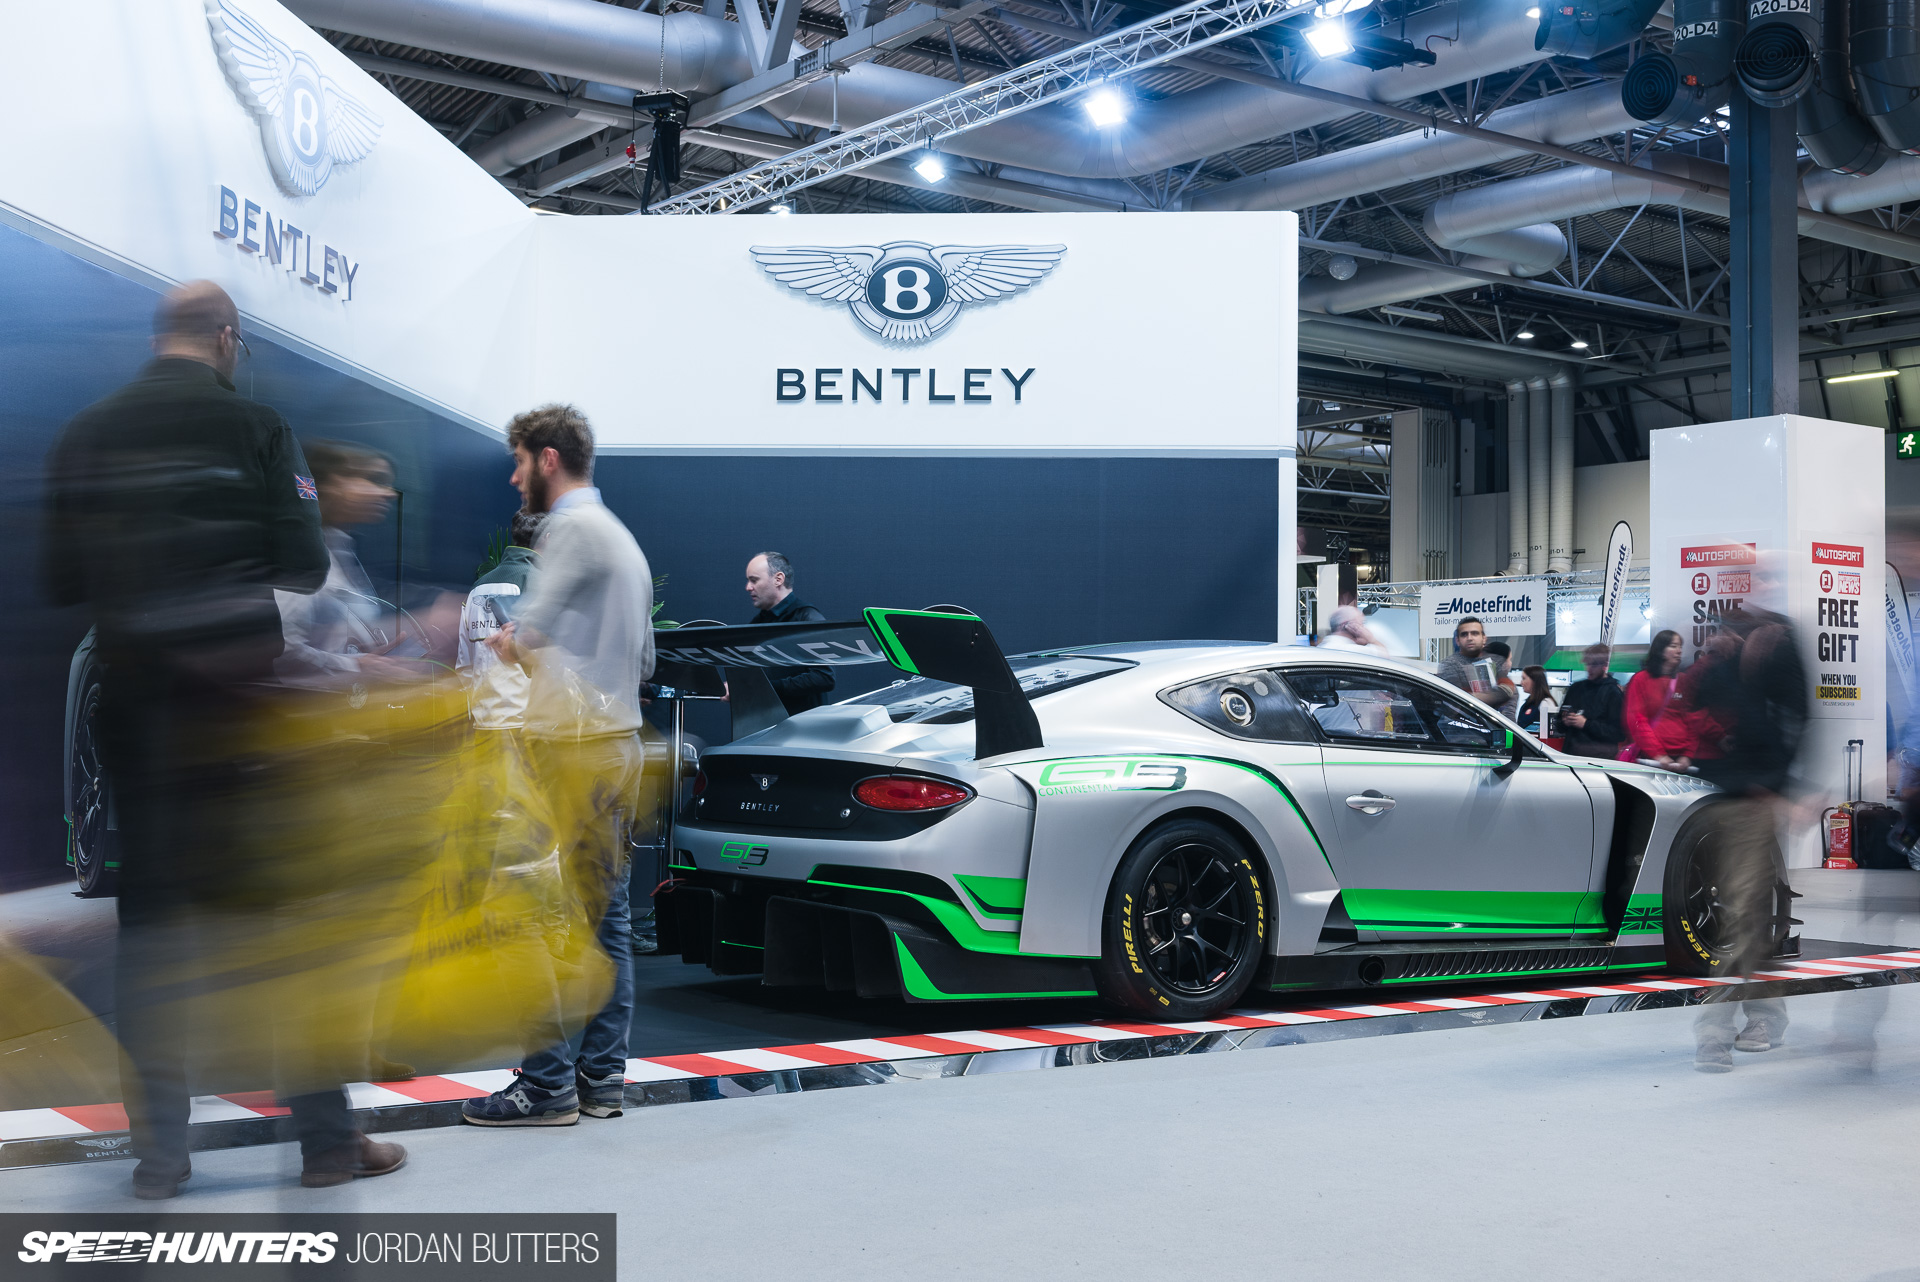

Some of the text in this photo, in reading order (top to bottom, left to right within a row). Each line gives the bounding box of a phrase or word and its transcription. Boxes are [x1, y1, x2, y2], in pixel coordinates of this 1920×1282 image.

[1751, 0, 1810, 18] A20-D4
[1674, 21, 1718, 44] 20-D4
[214, 184, 359, 301] BENTLEY
[776, 367, 1036, 401] BENTLEY
[1689, 550, 1751, 562] AUTOSPORT
[1818, 548, 1861, 562] AUTOSPORT
[1603, 543, 1627, 637] Moetefindt
[1718, 580, 1750, 593] NEWS
[1838, 580, 1860, 594] NEWS
[1436, 593, 1532, 615] Moetefindt
[1818, 597, 1859, 628] FREE
[471, 619, 501, 630] BENTLE
[1494, 614, 1507, 623] and
[1508, 614, 1532, 622] trailers
[1818, 632, 1859, 663] GIFT
[1821, 673, 1857, 686] WHEN YOU
[1820, 686, 1858, 699] SUBSCRIBE
[1039, 760, 1188, 791] GT3
[1038, 784, 1114, 797] CONTINENTAL
[740, 802, 780, 812] BENTLEY
[720, 841, 770, 866] GT3
[1241, 859, 1264, 938] P ZERO
[1122, 893, 1144, 974] PIRELLI
[1681, 919, 1711, 960] ZERO
[85, 1149, 133, 1158] BENTLE
